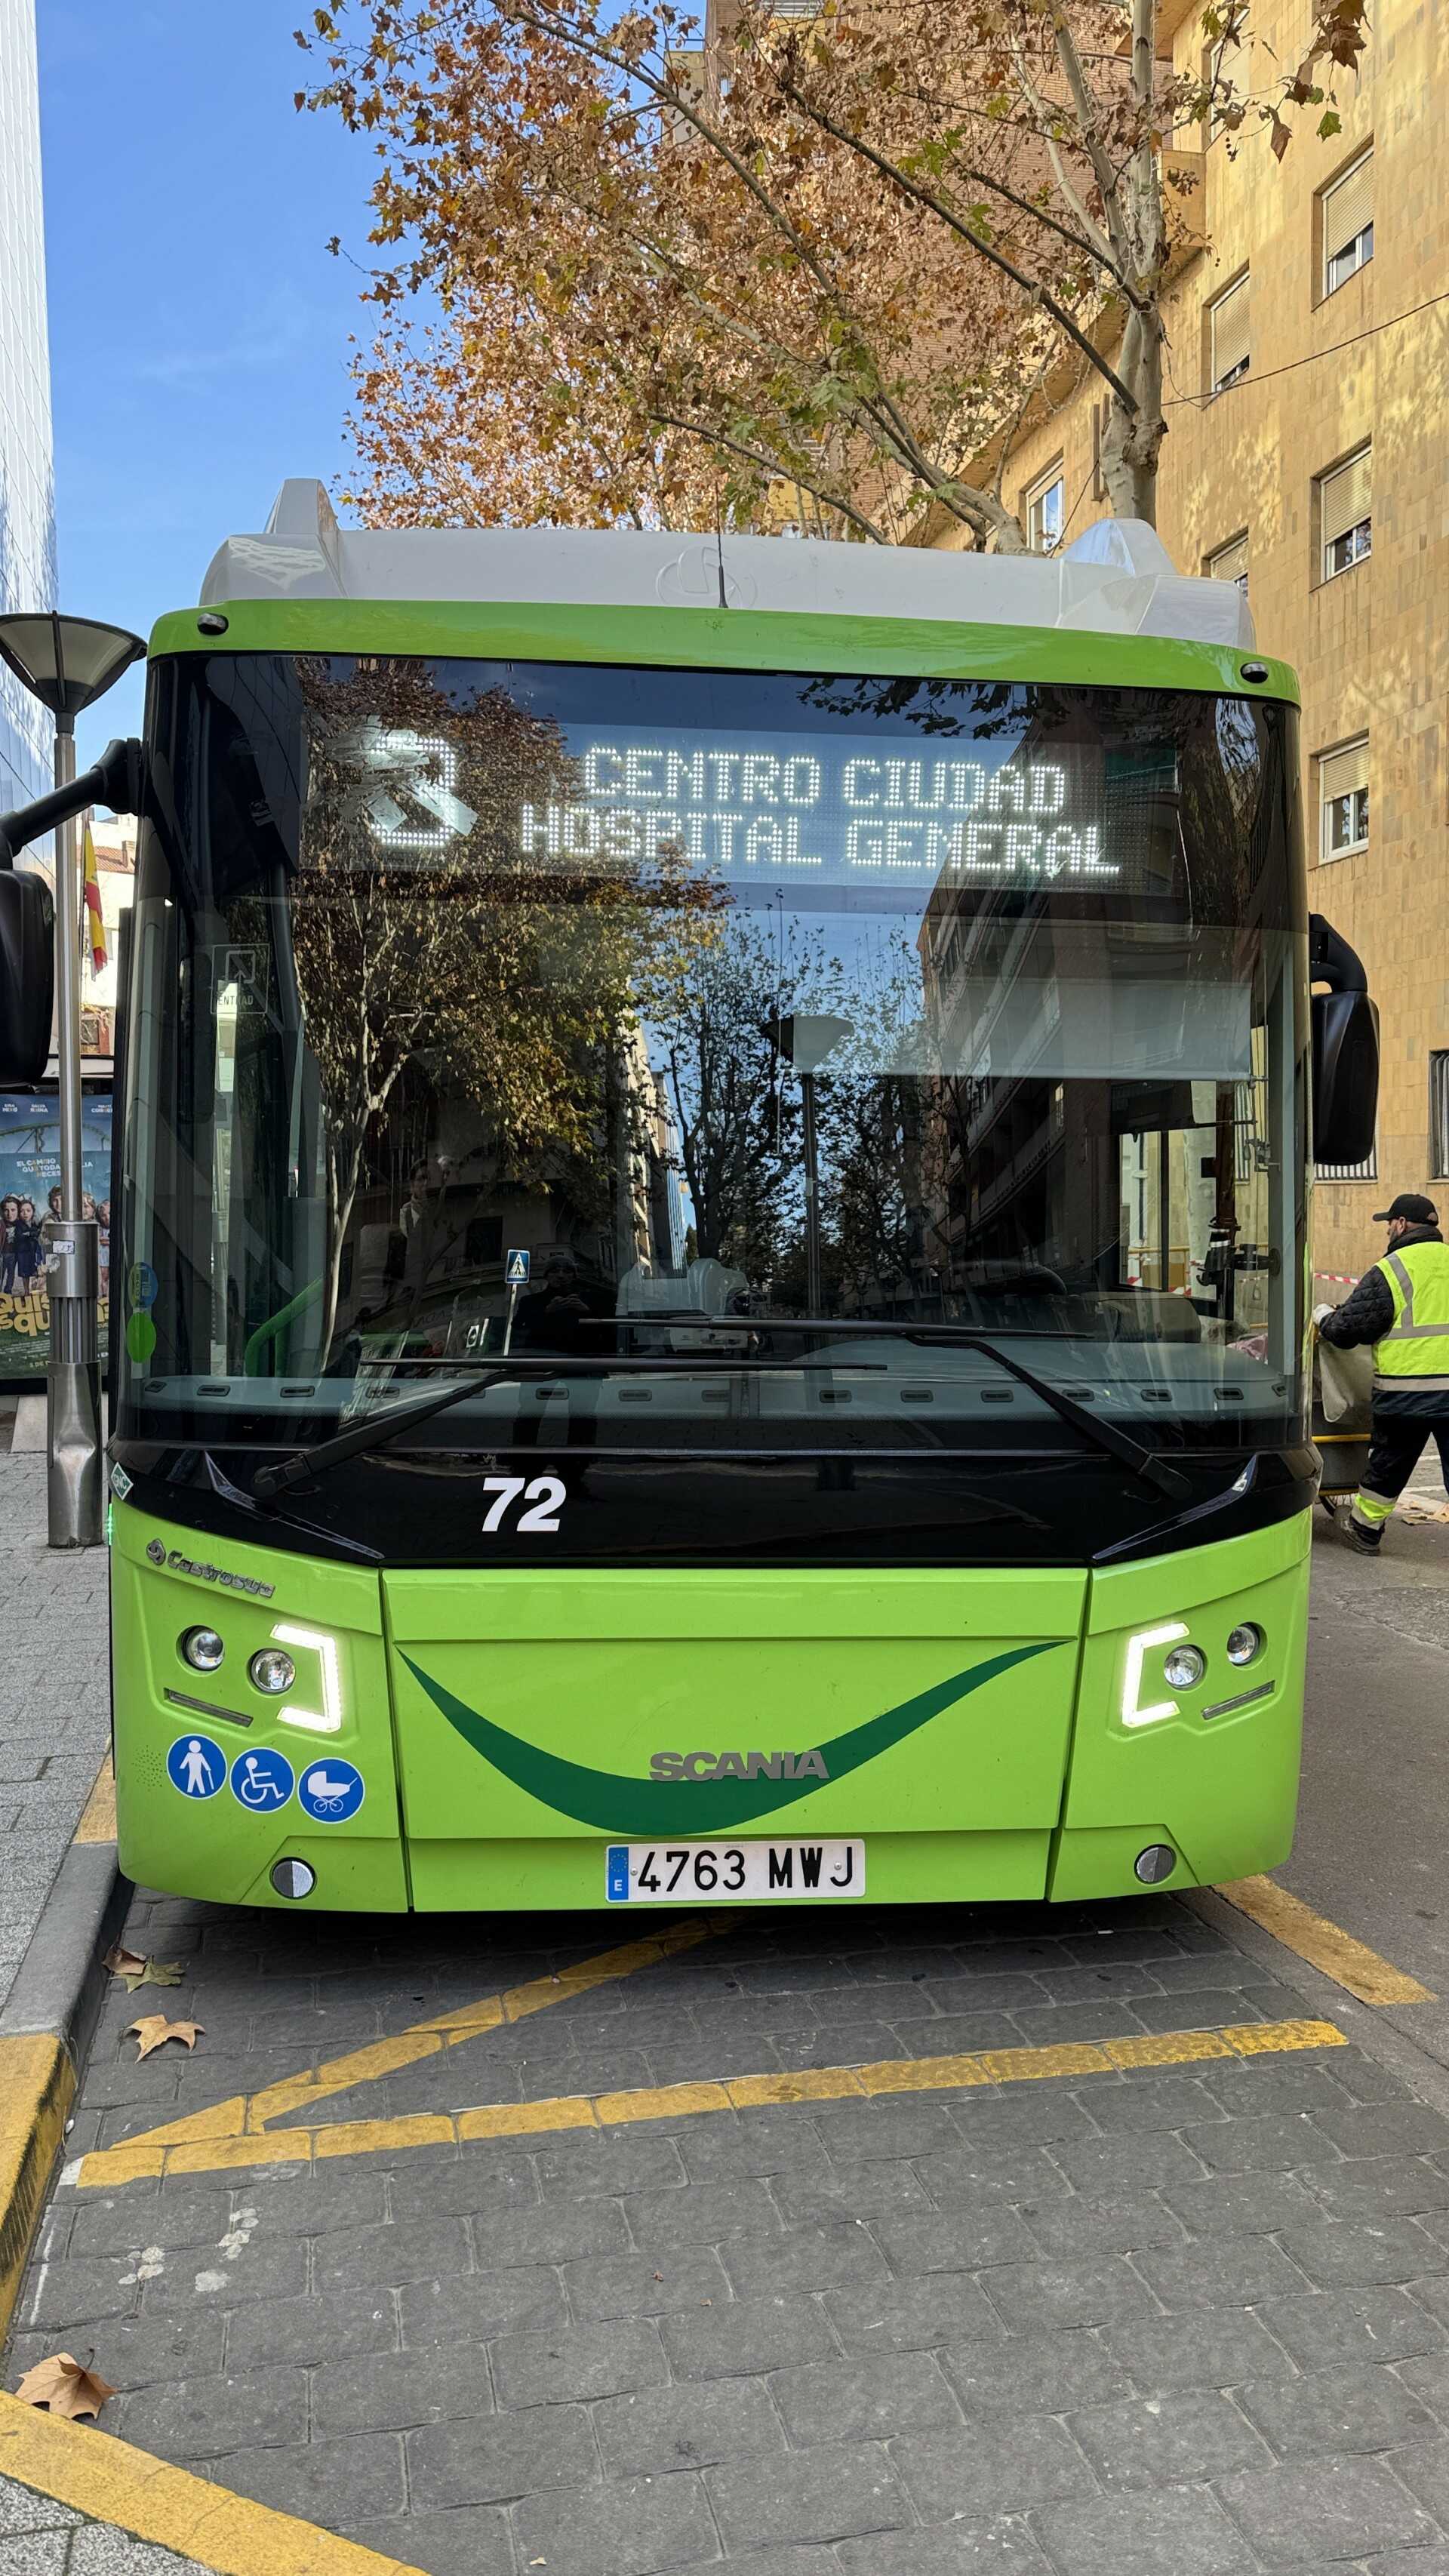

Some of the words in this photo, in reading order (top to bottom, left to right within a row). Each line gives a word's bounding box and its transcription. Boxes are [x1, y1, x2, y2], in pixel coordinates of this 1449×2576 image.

[368, 734, 457, 846] 3
[584, 746, 821, 803] CENTRO
[843, 759, 1066, 811] CIUDAD
[521, 803, 823, 864] HOSPITAL
[846, 818, 1121, 873] GENERAL
[481, 1476, 567, 1531] 72
[649, 1750, 830, 1782] SCANIA
[614, 1879, 623, 1891] E
[638, 1849, 746, 1893] 4763
[768, 1846, 853, 1888] MWJ
